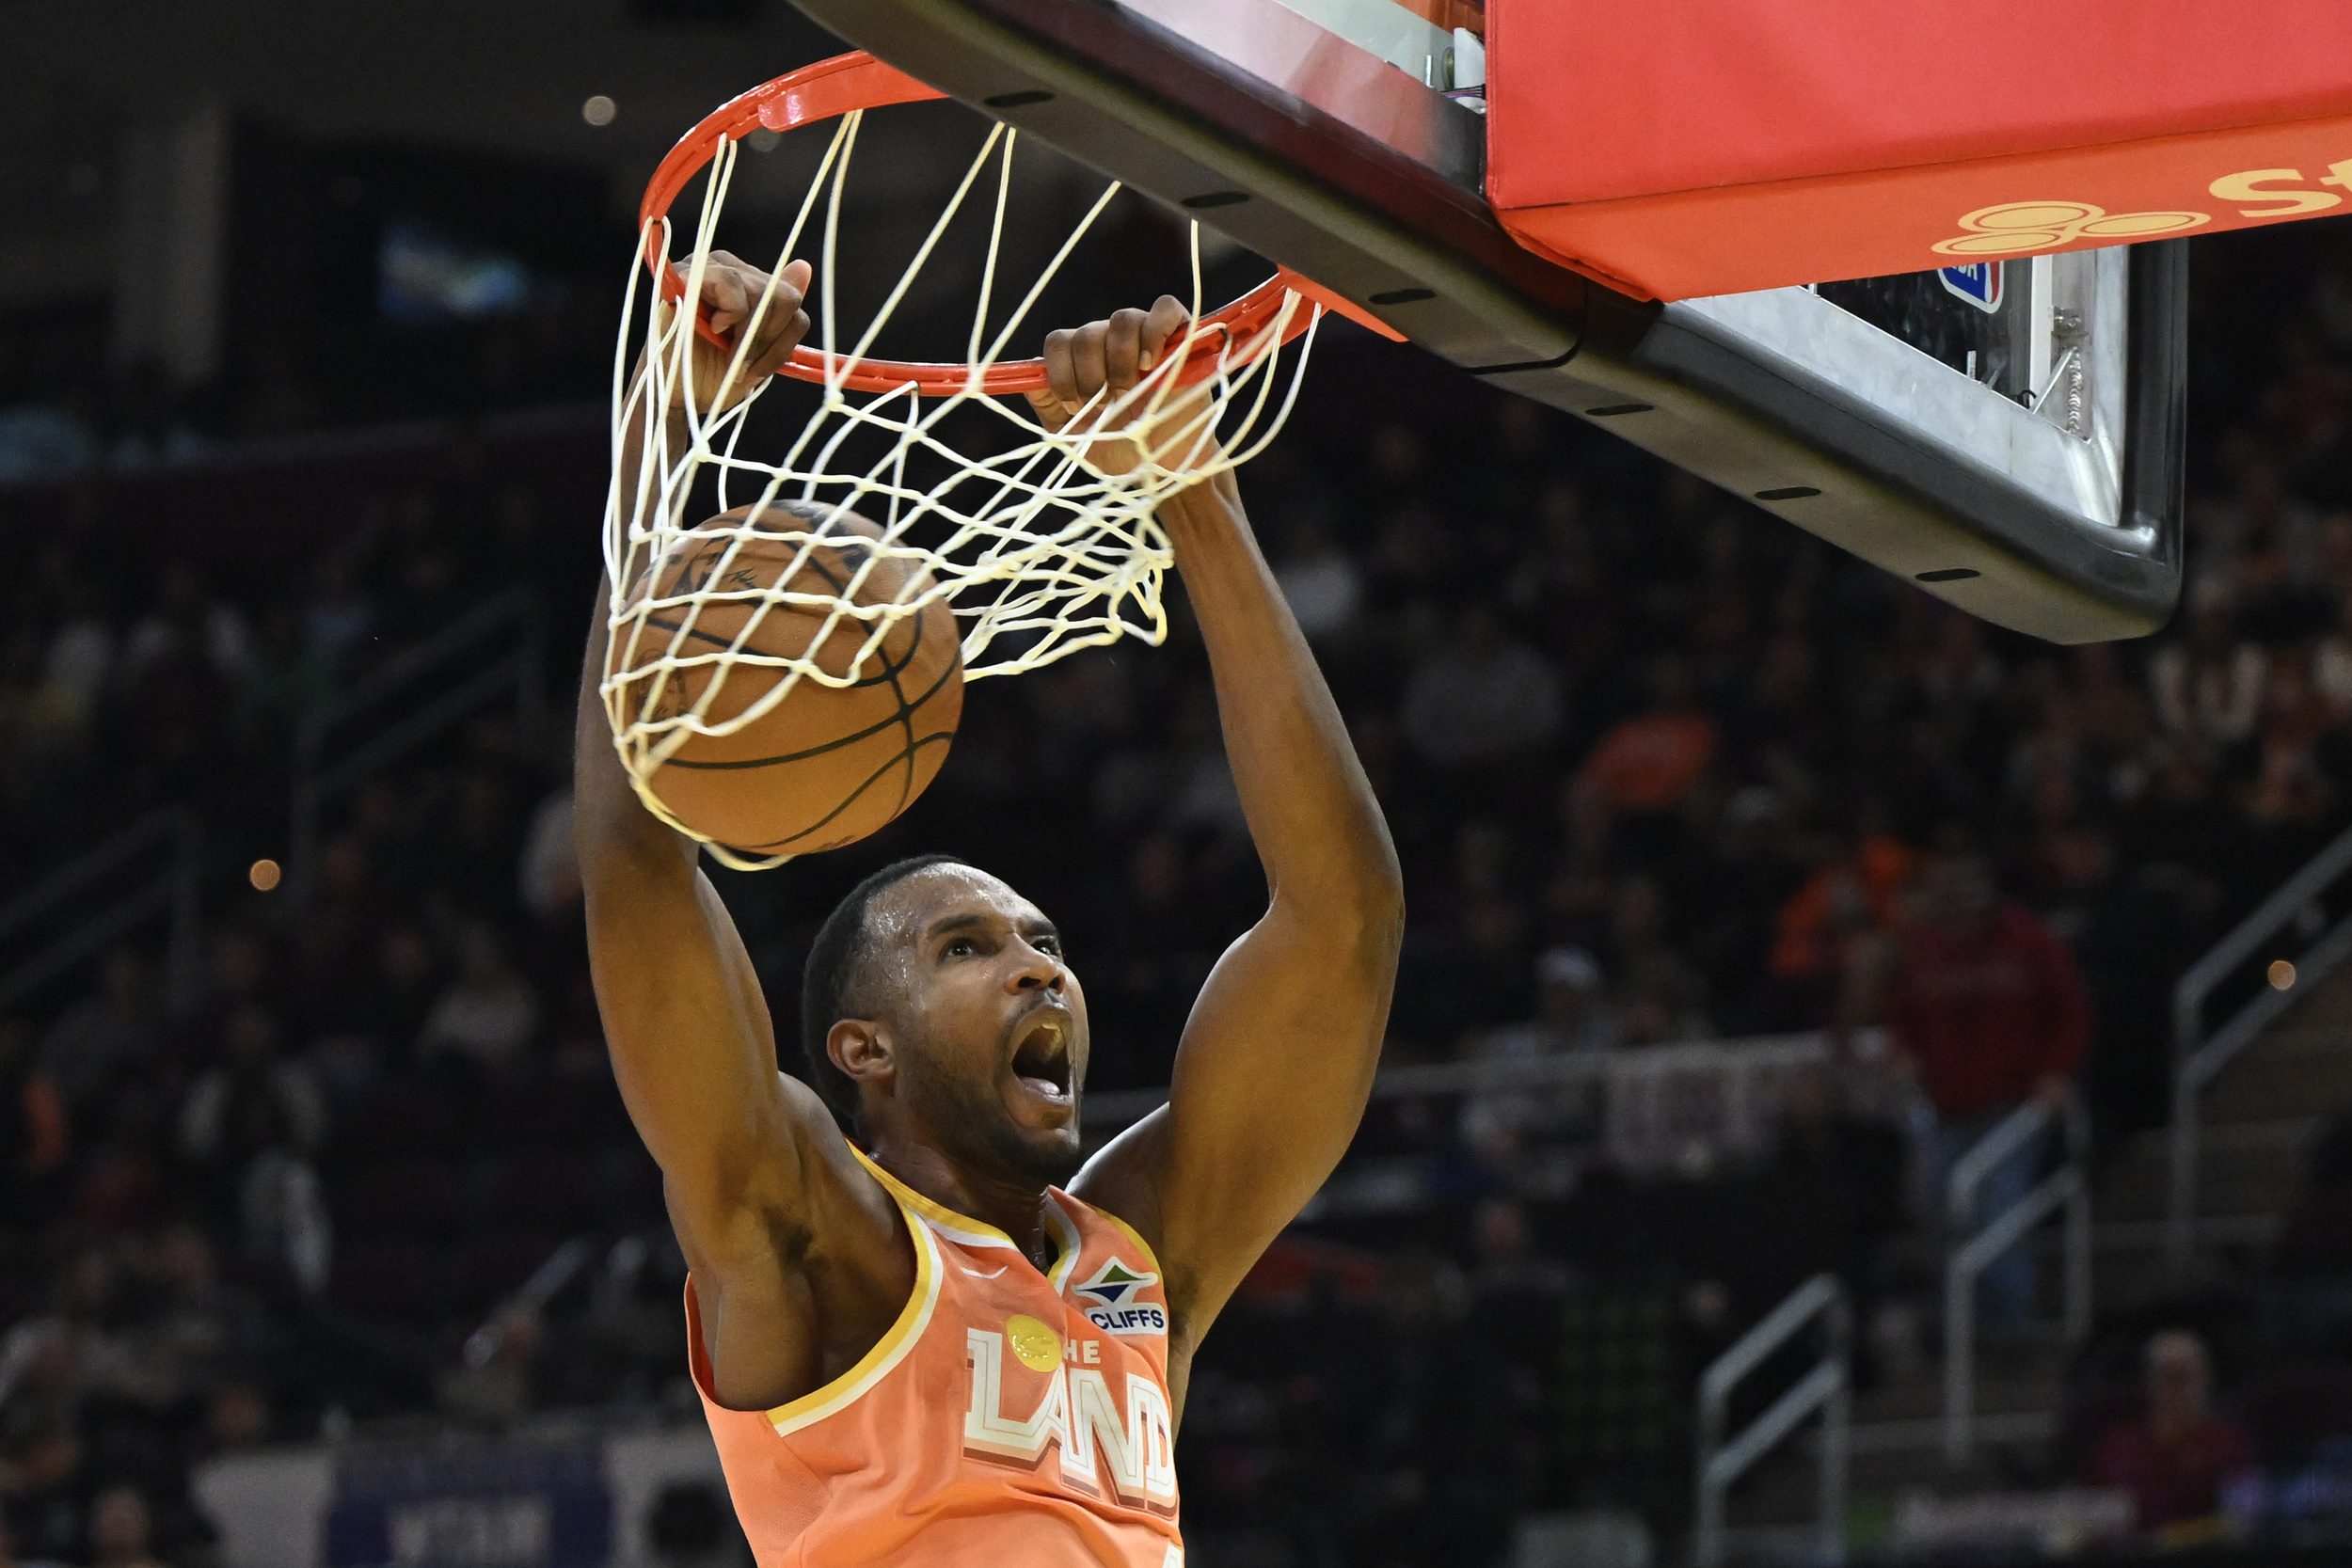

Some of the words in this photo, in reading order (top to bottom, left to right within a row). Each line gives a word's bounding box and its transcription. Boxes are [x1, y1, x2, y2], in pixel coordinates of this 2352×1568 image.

[1091, 1309, 1165, 1330] CLIFFS
[1063, 1339, 1102, 1364] HE
[963, 1327, 1177, 1518] LAND
